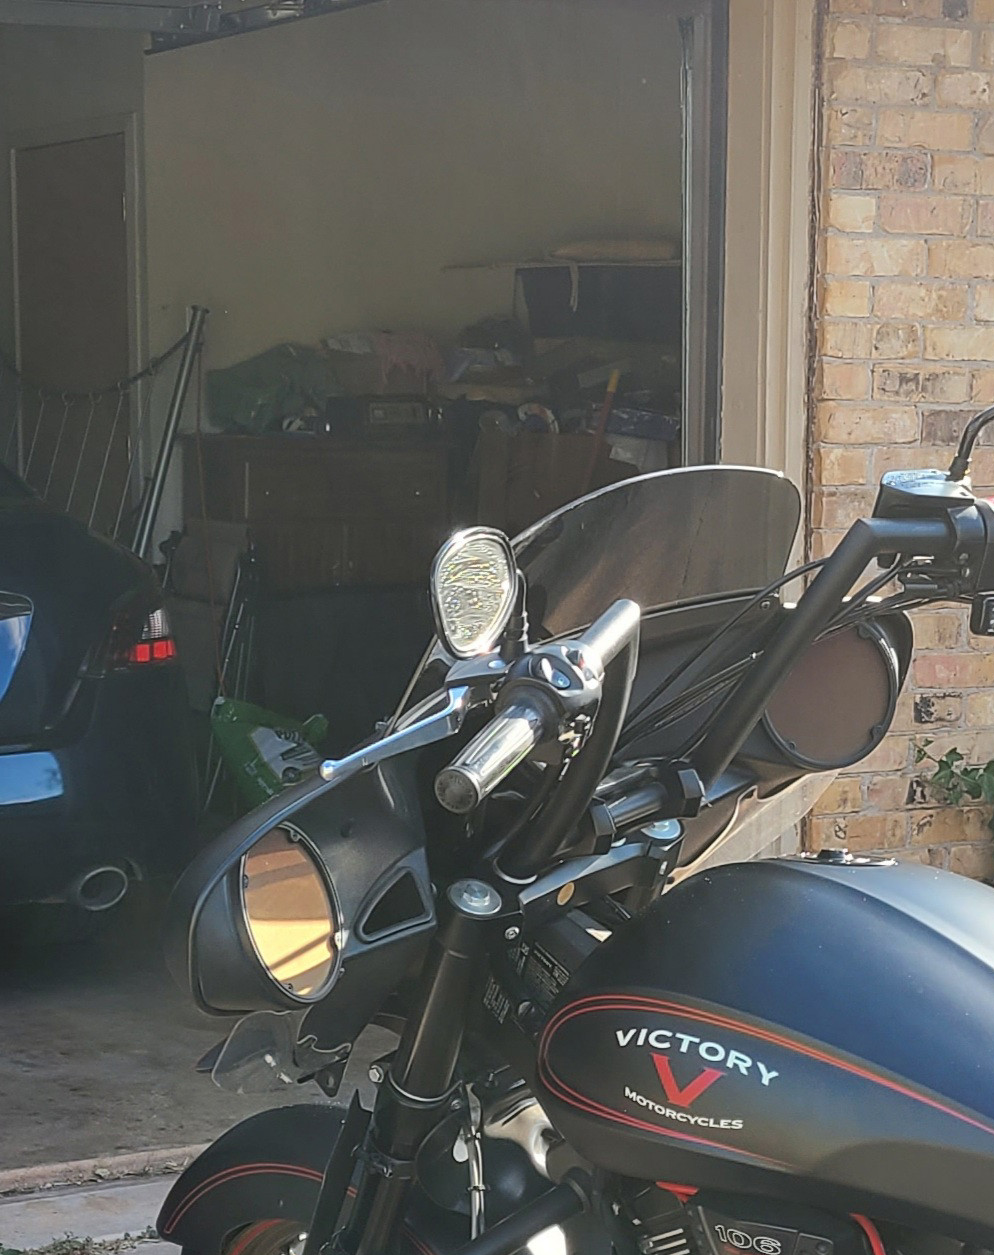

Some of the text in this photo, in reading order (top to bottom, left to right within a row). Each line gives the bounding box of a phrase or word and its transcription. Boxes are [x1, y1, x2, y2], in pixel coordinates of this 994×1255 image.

[615, 1028, 779, 1086] VICTORY
[651, 1053, 725, 1108] V
[624, 1086, 744, 1130] MOTORCYCLES
[714, 1224, 782, 1255] 106
